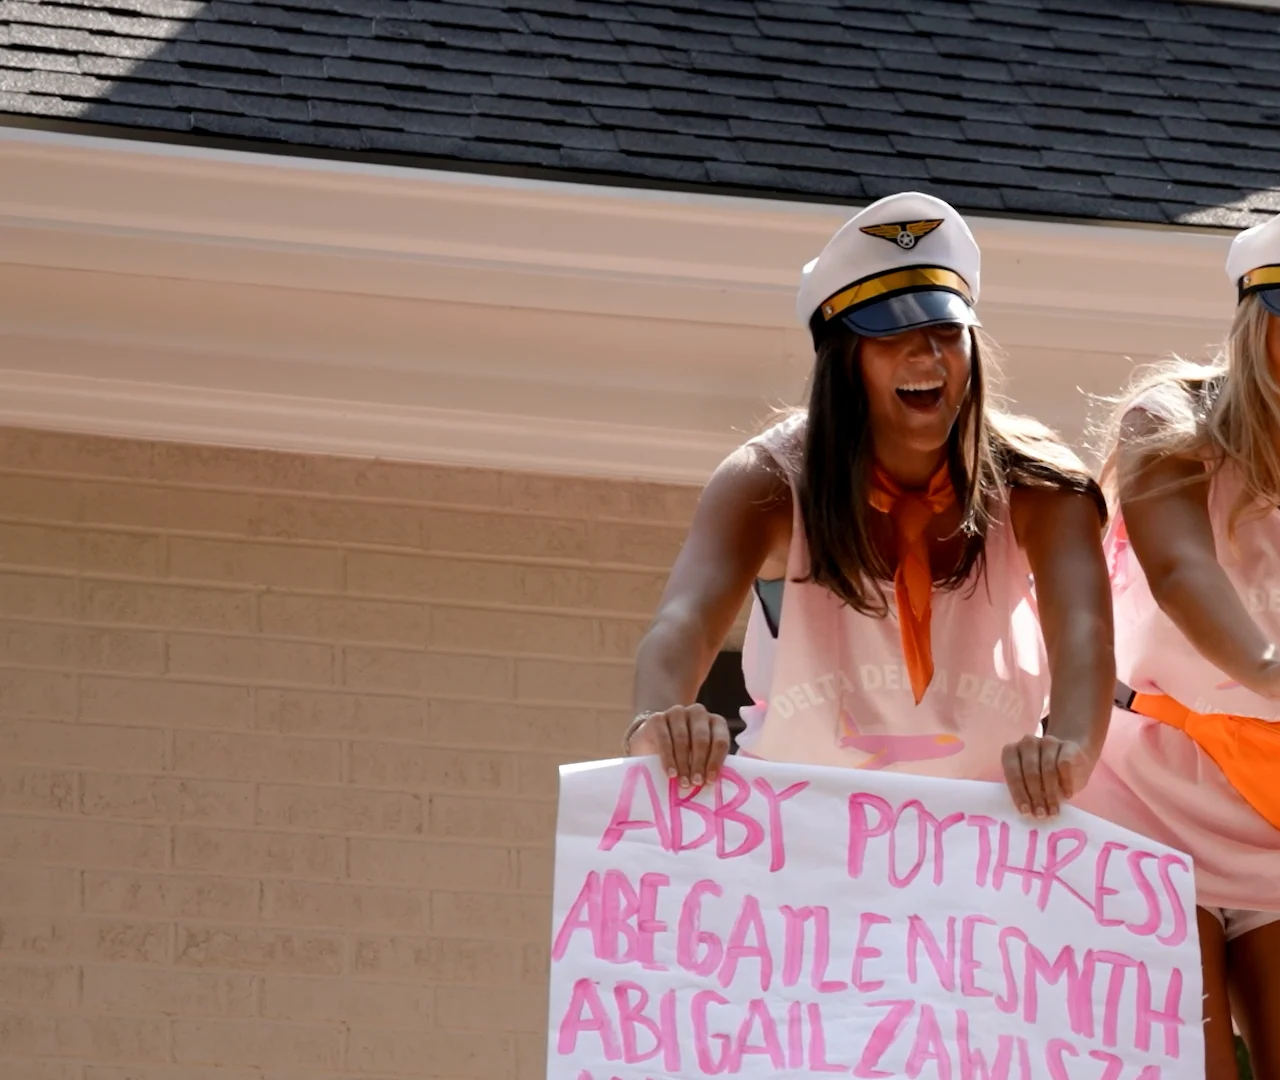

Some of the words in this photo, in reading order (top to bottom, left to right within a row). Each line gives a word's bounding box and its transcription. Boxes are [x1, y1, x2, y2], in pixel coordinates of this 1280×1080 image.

[772, 668, 855, 719] DELTA
[859, 663, 948, 694] DELA
[600, 765, 809, 872] ABBY
[848, 793, 1188, 946] POYTHRESS
[557, 977, 849, 1076] ABIGAIL
[908, 914, 1185, 1058] NESMITH
